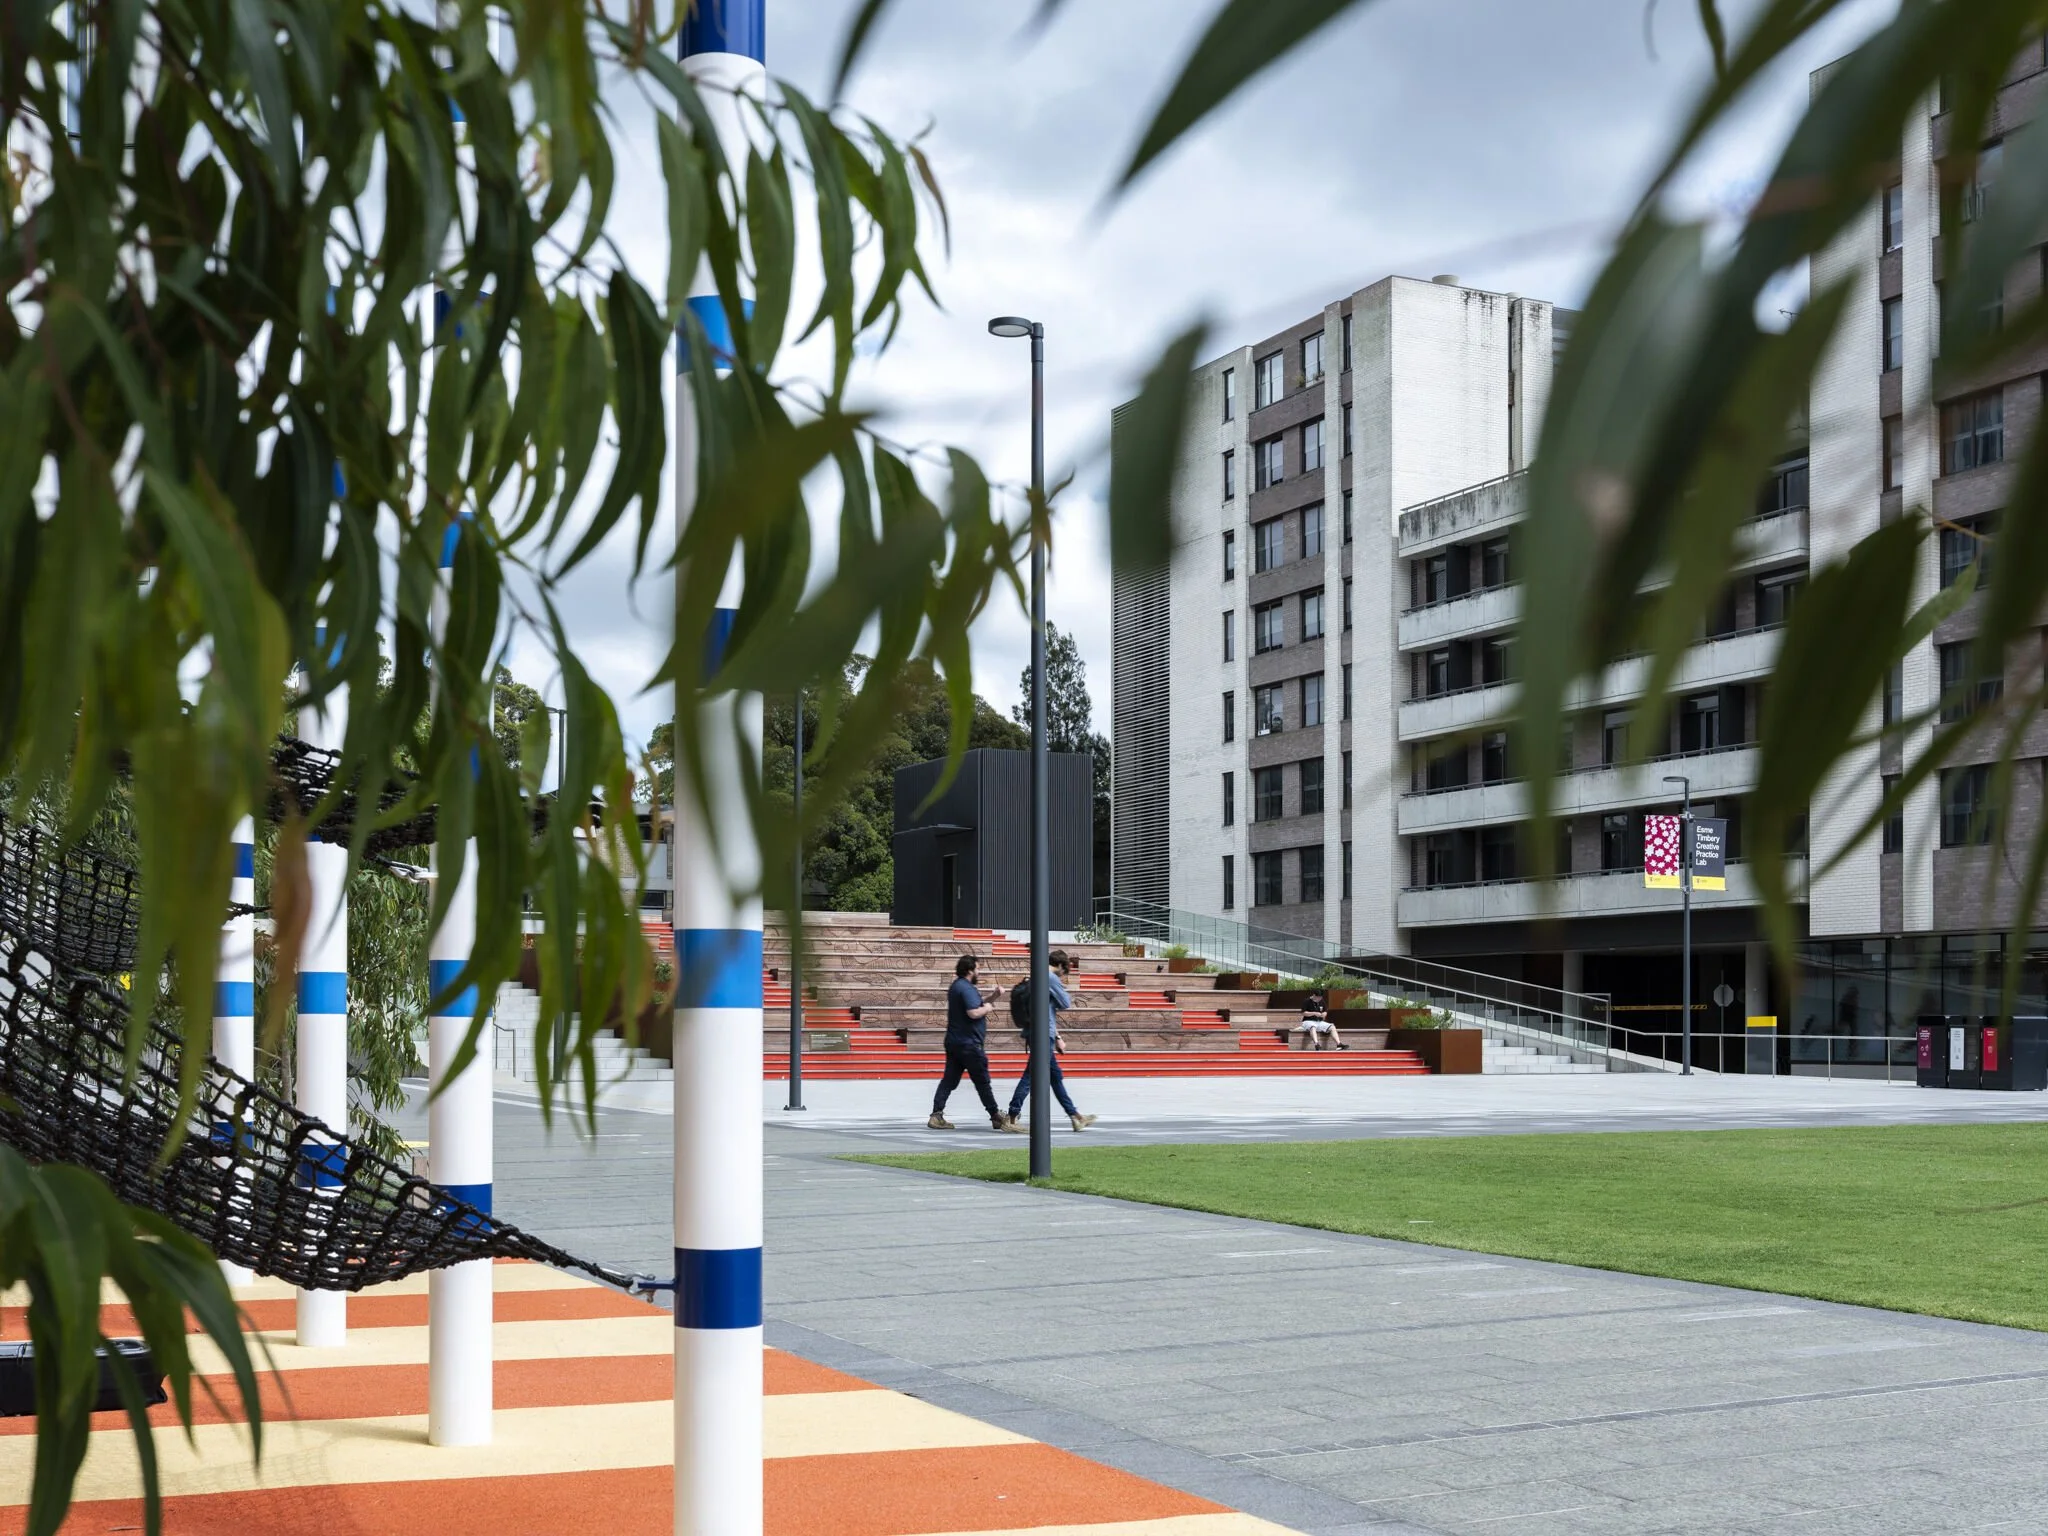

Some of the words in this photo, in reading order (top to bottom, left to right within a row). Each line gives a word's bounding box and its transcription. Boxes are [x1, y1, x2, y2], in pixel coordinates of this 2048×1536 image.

[1696, 842, 1719, 850] Creative
[1696, 850, 1719, 858] Practice
[1696, 858, 1707, 866] Lab
